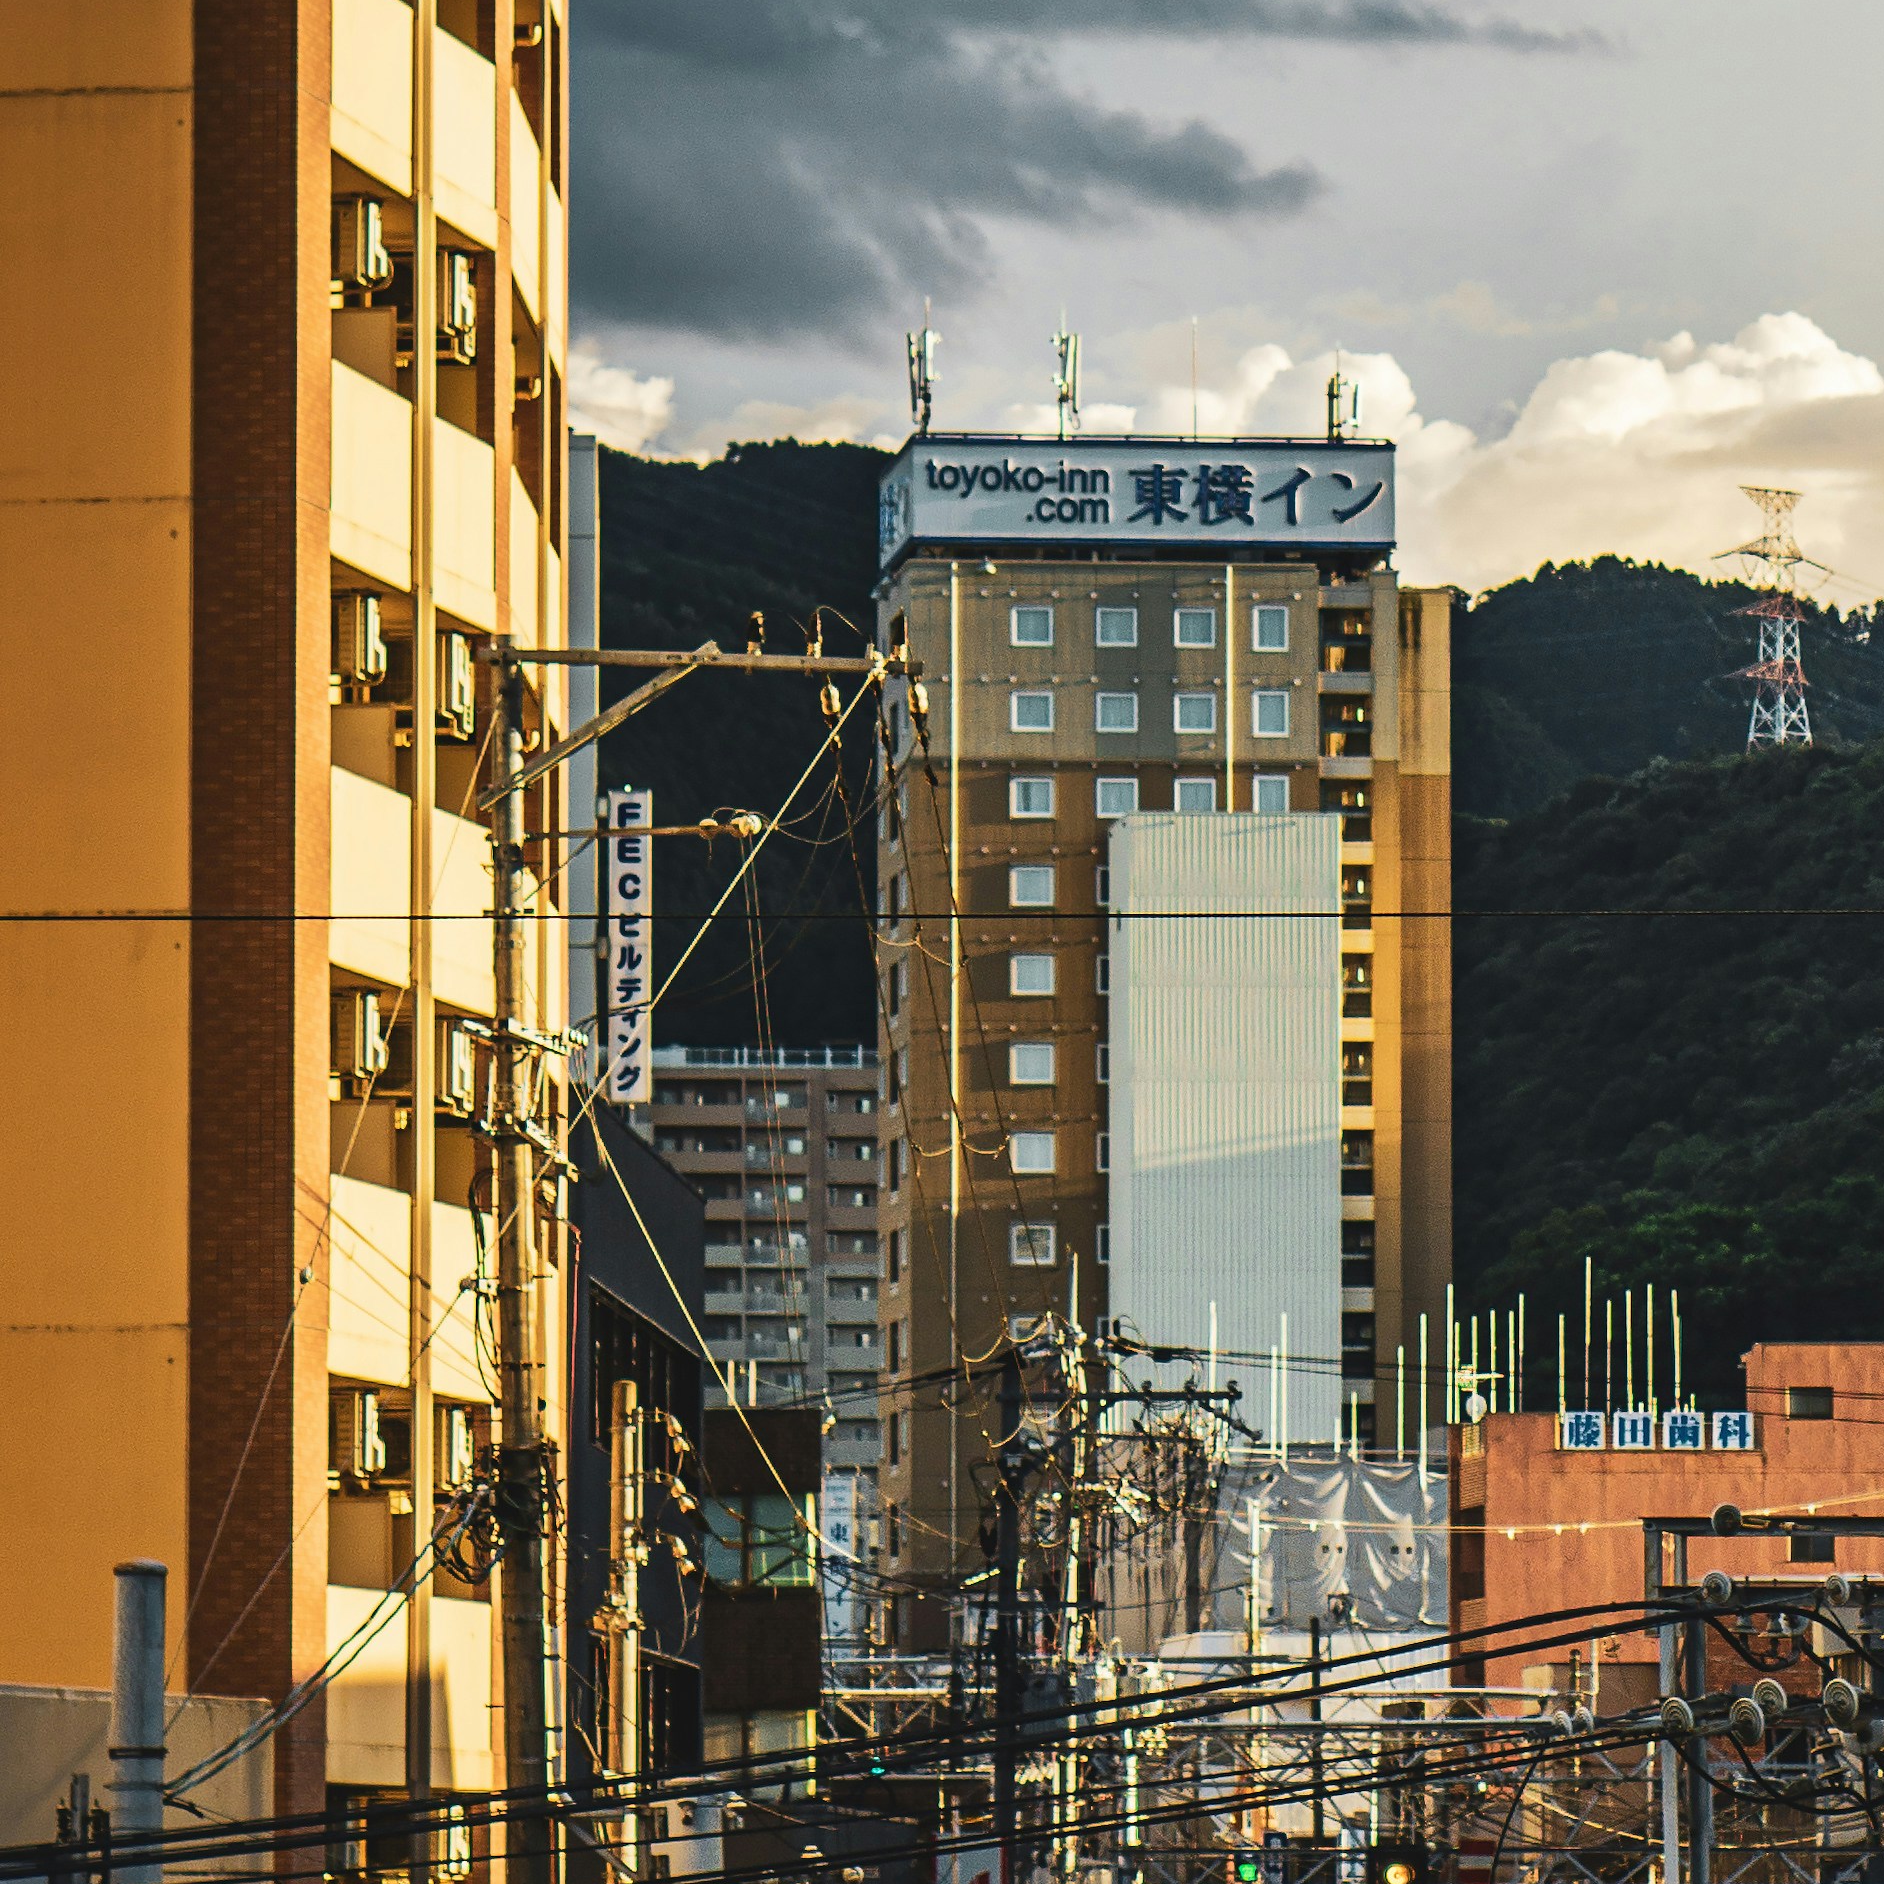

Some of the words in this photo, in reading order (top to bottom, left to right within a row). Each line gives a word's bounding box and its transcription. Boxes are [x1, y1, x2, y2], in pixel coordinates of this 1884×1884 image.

[925, 459, 1110, 498] toyoko-inn
[1127, 463, 1384, 527] 東横イン
[1025, 498, 1110, 524] .com
